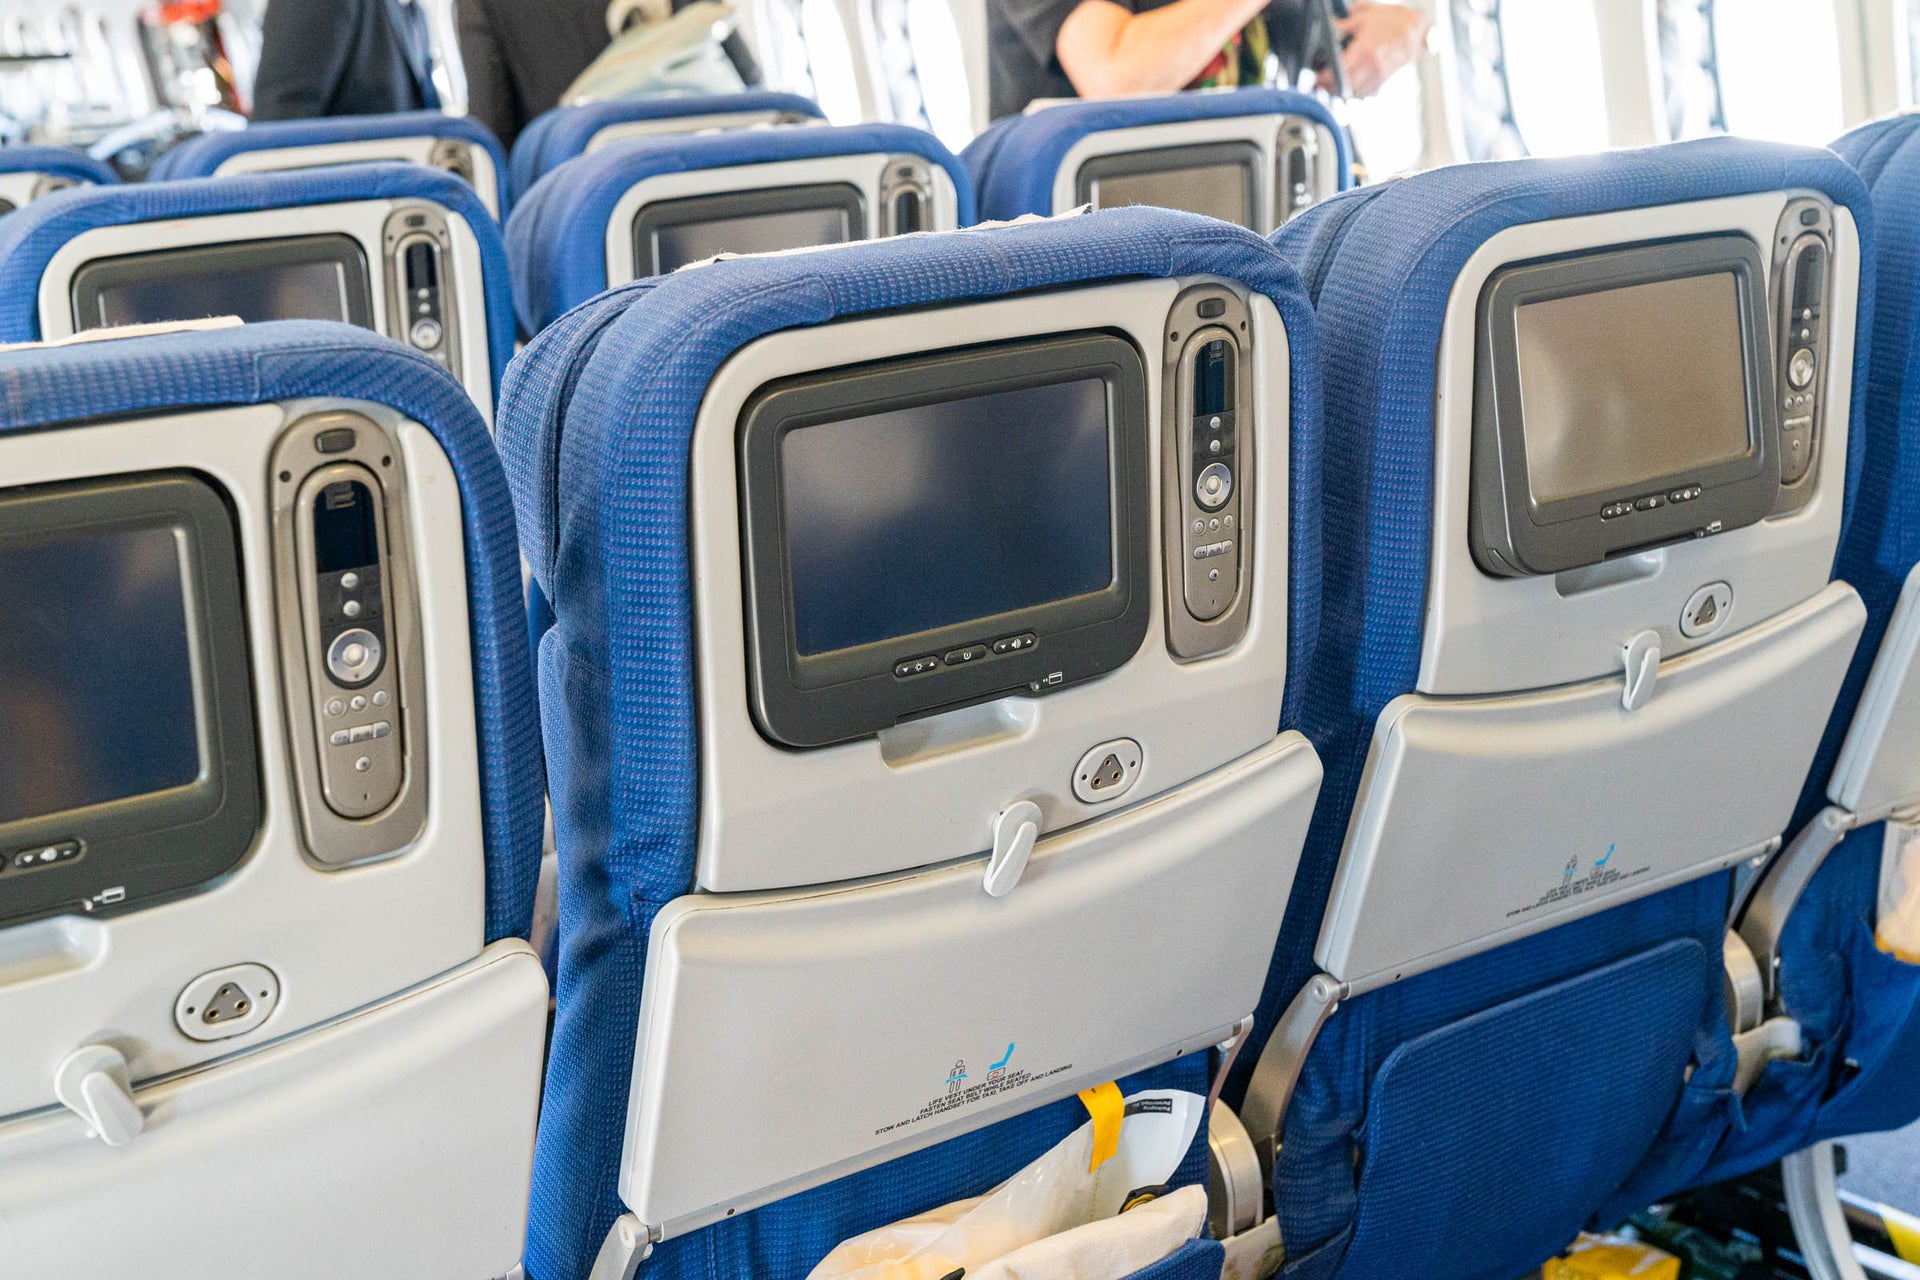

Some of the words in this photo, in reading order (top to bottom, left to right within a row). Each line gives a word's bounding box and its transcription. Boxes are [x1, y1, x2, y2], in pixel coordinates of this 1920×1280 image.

[874, 1124, 895, 1135] STOW
[895, 1119, 911, 1128] AND
[911, 1111, 933, 1123] LATCH
[934, 1101, 965, 1115] HANDSET
[966, 1095, 980, 1105] FOR
[999, 1083, 1015, 1093] TAKE
[1016, 1078, 1028, 1087] OFF
[1029, 1073, 1044, 1082] AND
[1044, 1063, 1073, 1077] LANDING
[919, 1102, 946, 1114] FASTEN
[947, 1096, 965, 1107] SEAT
[965, 1088, 982, 1099] BELT
[984, 1081, 1006, 1093] WHILE
[1006, 1072, 1032, 1085] SEATED
[928, 1096, 943, 1107] LIFE
[944, 1090, 962, 1101] VEST
[963, 1082, 987, 1094] UNDER
[988, 1076, 1006, 1086] YOUR
[1007, 1069, 1025, 1079] SEAT
